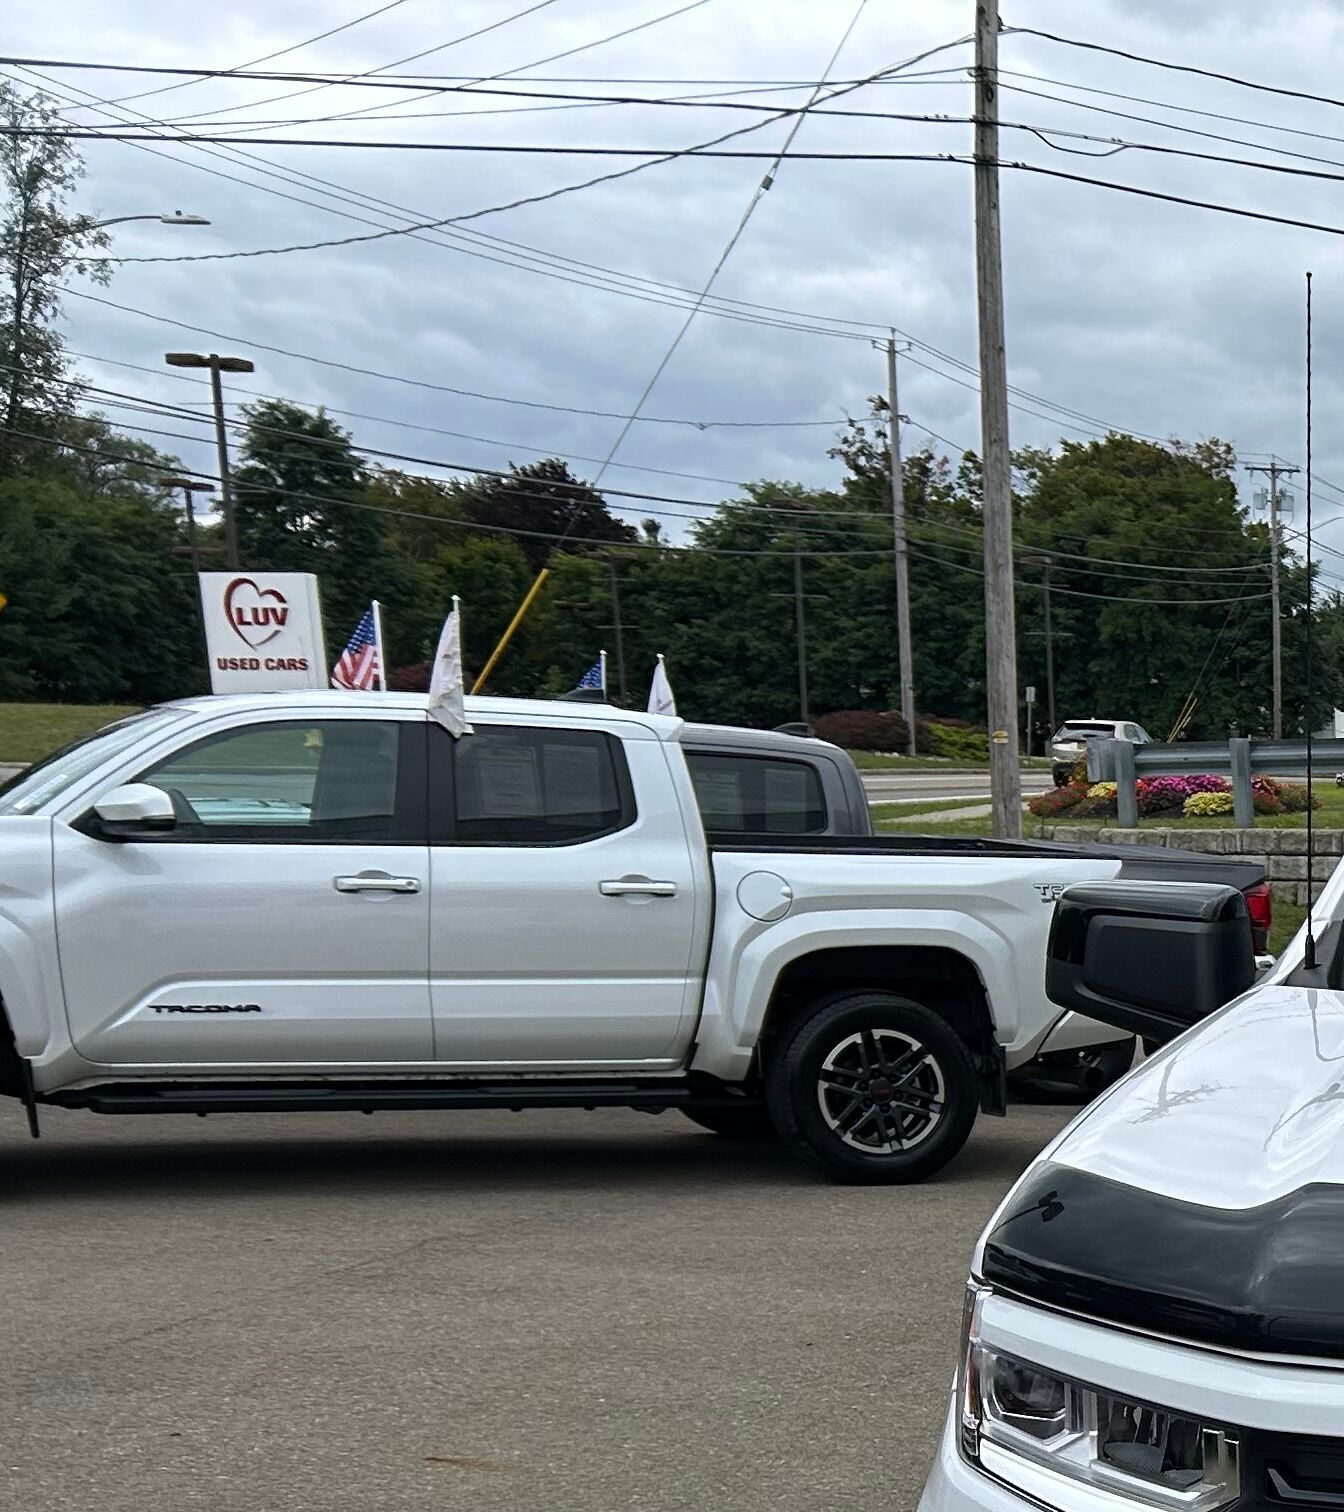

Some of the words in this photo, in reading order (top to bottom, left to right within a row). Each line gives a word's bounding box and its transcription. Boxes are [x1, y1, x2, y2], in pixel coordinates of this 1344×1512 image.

[235, 606, 289, 627] LUV
[216, 657, 260, 672] USED
[264, 657, 309, 672] CARS
[147, 1004, 262, 1014] TACOMA
